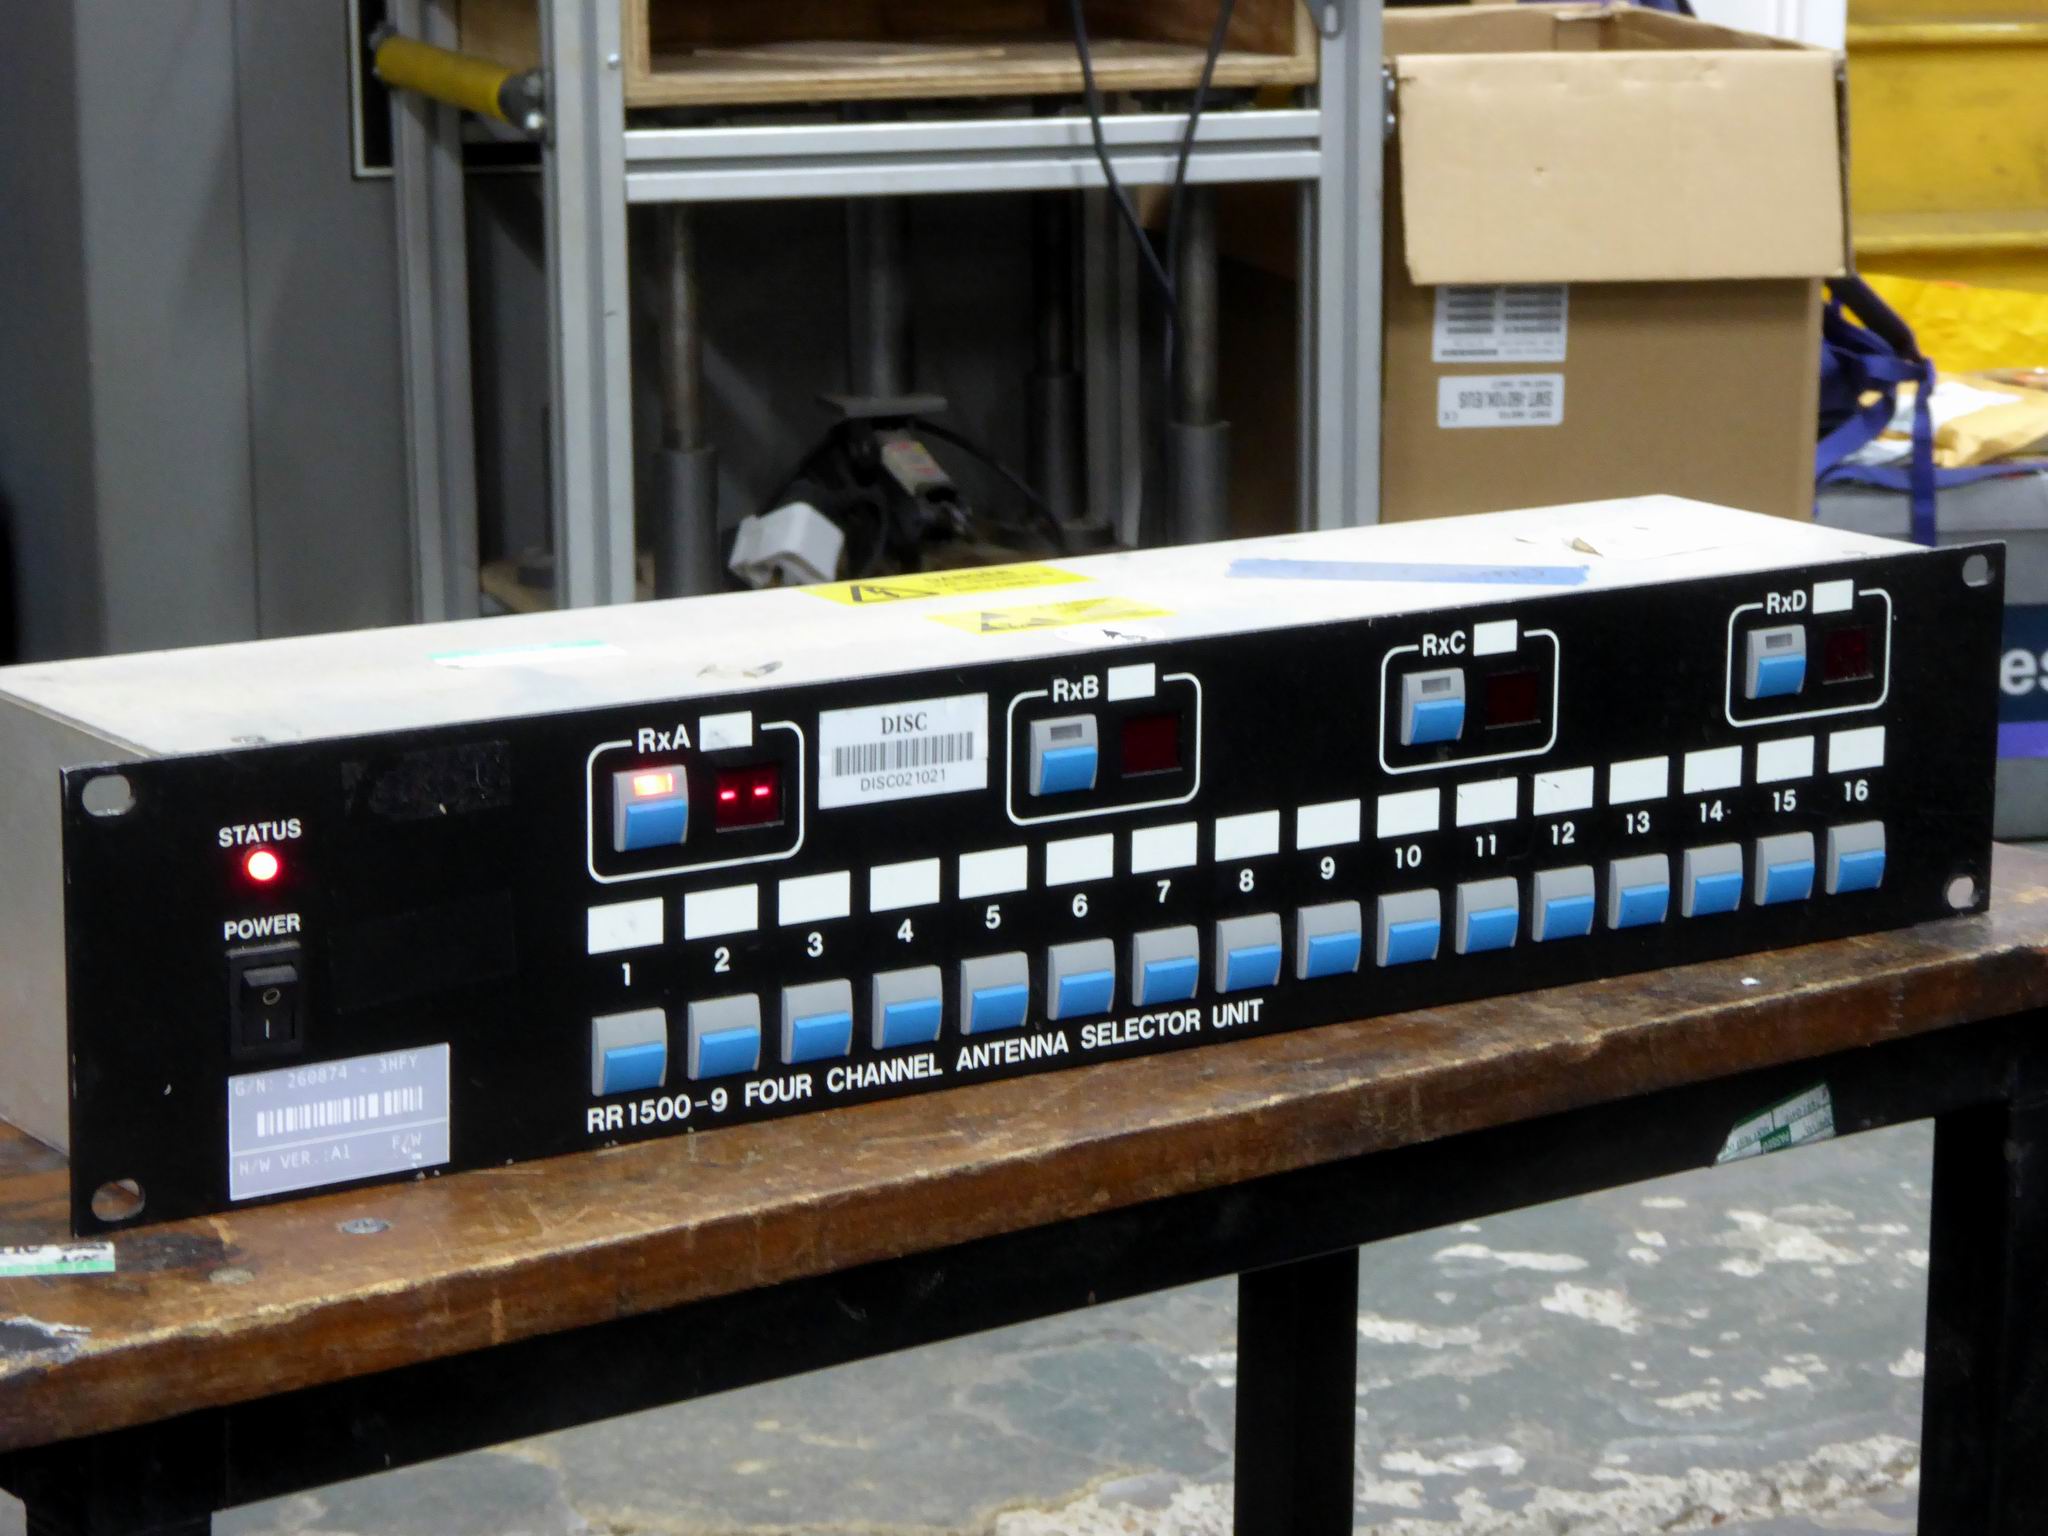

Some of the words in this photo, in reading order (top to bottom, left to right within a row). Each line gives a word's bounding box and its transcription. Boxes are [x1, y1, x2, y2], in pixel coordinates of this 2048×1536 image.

[1766, 589, 1807, 615] RxD
[1422, 630, 1466, 658] RxC
[1052, 674, 1100, 703] RxB
[881, 712, 928, 735] DISC
[638, 723, 691, 754] RxA
[860, 767, 946, 791] DISC021021
[1844, 779, 1869, 802] 16
[1700, 799, 1724, 823] 14
[1773, 788, 1797, 812] 15
[218, 818, 302, 847] STATUS
[1551, 821, 1575, 846] 12
[1626, 810, 1650, 834] 13
[1395, 844, 1422, 869] 10
[1475, 834, 1497, 858] 11
[1238, 868, 1255, 893] 8
[1320, 856, 1336, 880] 9
[1156, 879, 1171, 904] 7
[985, 904, 1001, 930] 5
[1072, 893, 1089, 918] 6
[224, 913, 301, 941] POWER
[897, 918, 914, 943] 4
[807, 931, 824, 958] 3
[714, 946, 730, 973] 2
[621, 962, 631, 987] 1
[587, 1088, 728, 1134] RR1500-9
[744, 1073, 813, 1107] FOUR
[826, 1056, 944, 1093] CHANNEL
[955, 1033, 1070, 1072] ANTENNA
[1080, 1010, 1201, 1050] SELECTOR
[1212, 998, 1264, 1029] UNIT
